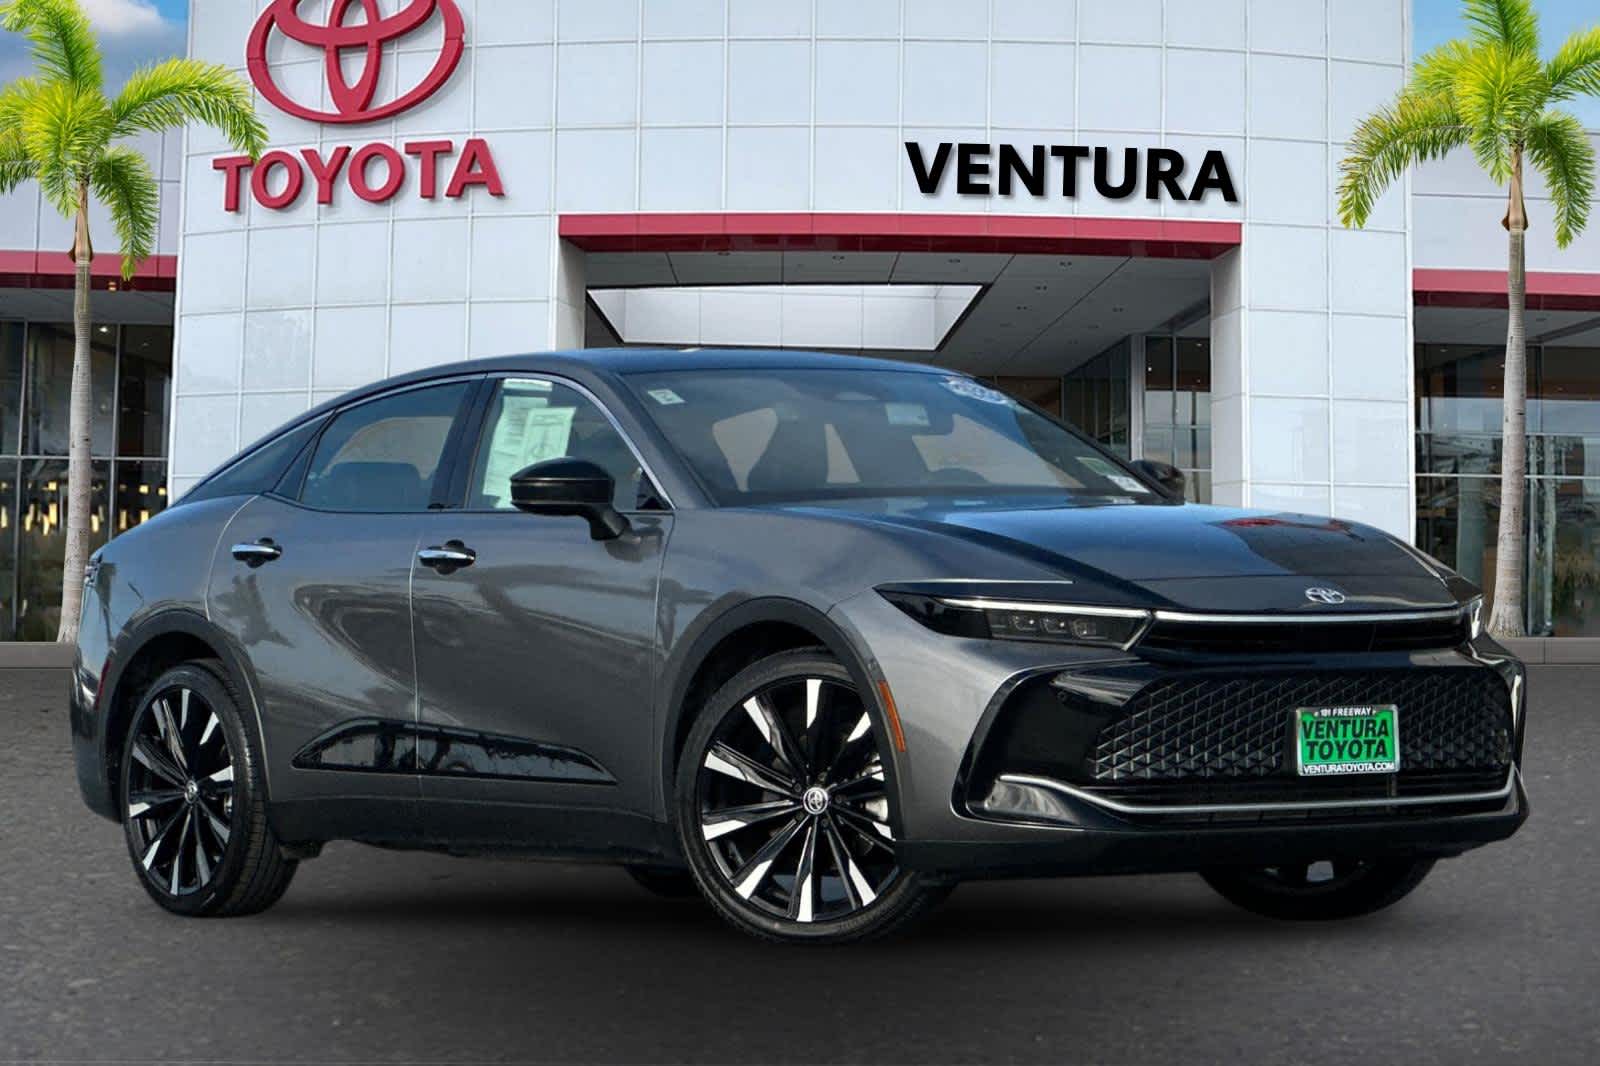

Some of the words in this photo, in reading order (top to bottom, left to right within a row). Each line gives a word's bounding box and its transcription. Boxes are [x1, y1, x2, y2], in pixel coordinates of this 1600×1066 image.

[212, 138, 505, 212] TOYOTA
[904, 141, 1239, 203] VENTURA
[1333, 707, 1371, 716] FREEWAY
[1302, 719, 1388, 739] VENTURA
[1305, 739, 1387, 760] TOYOTA
[1303, 762, 1394, 774] VENTURATOYOTA.COM
